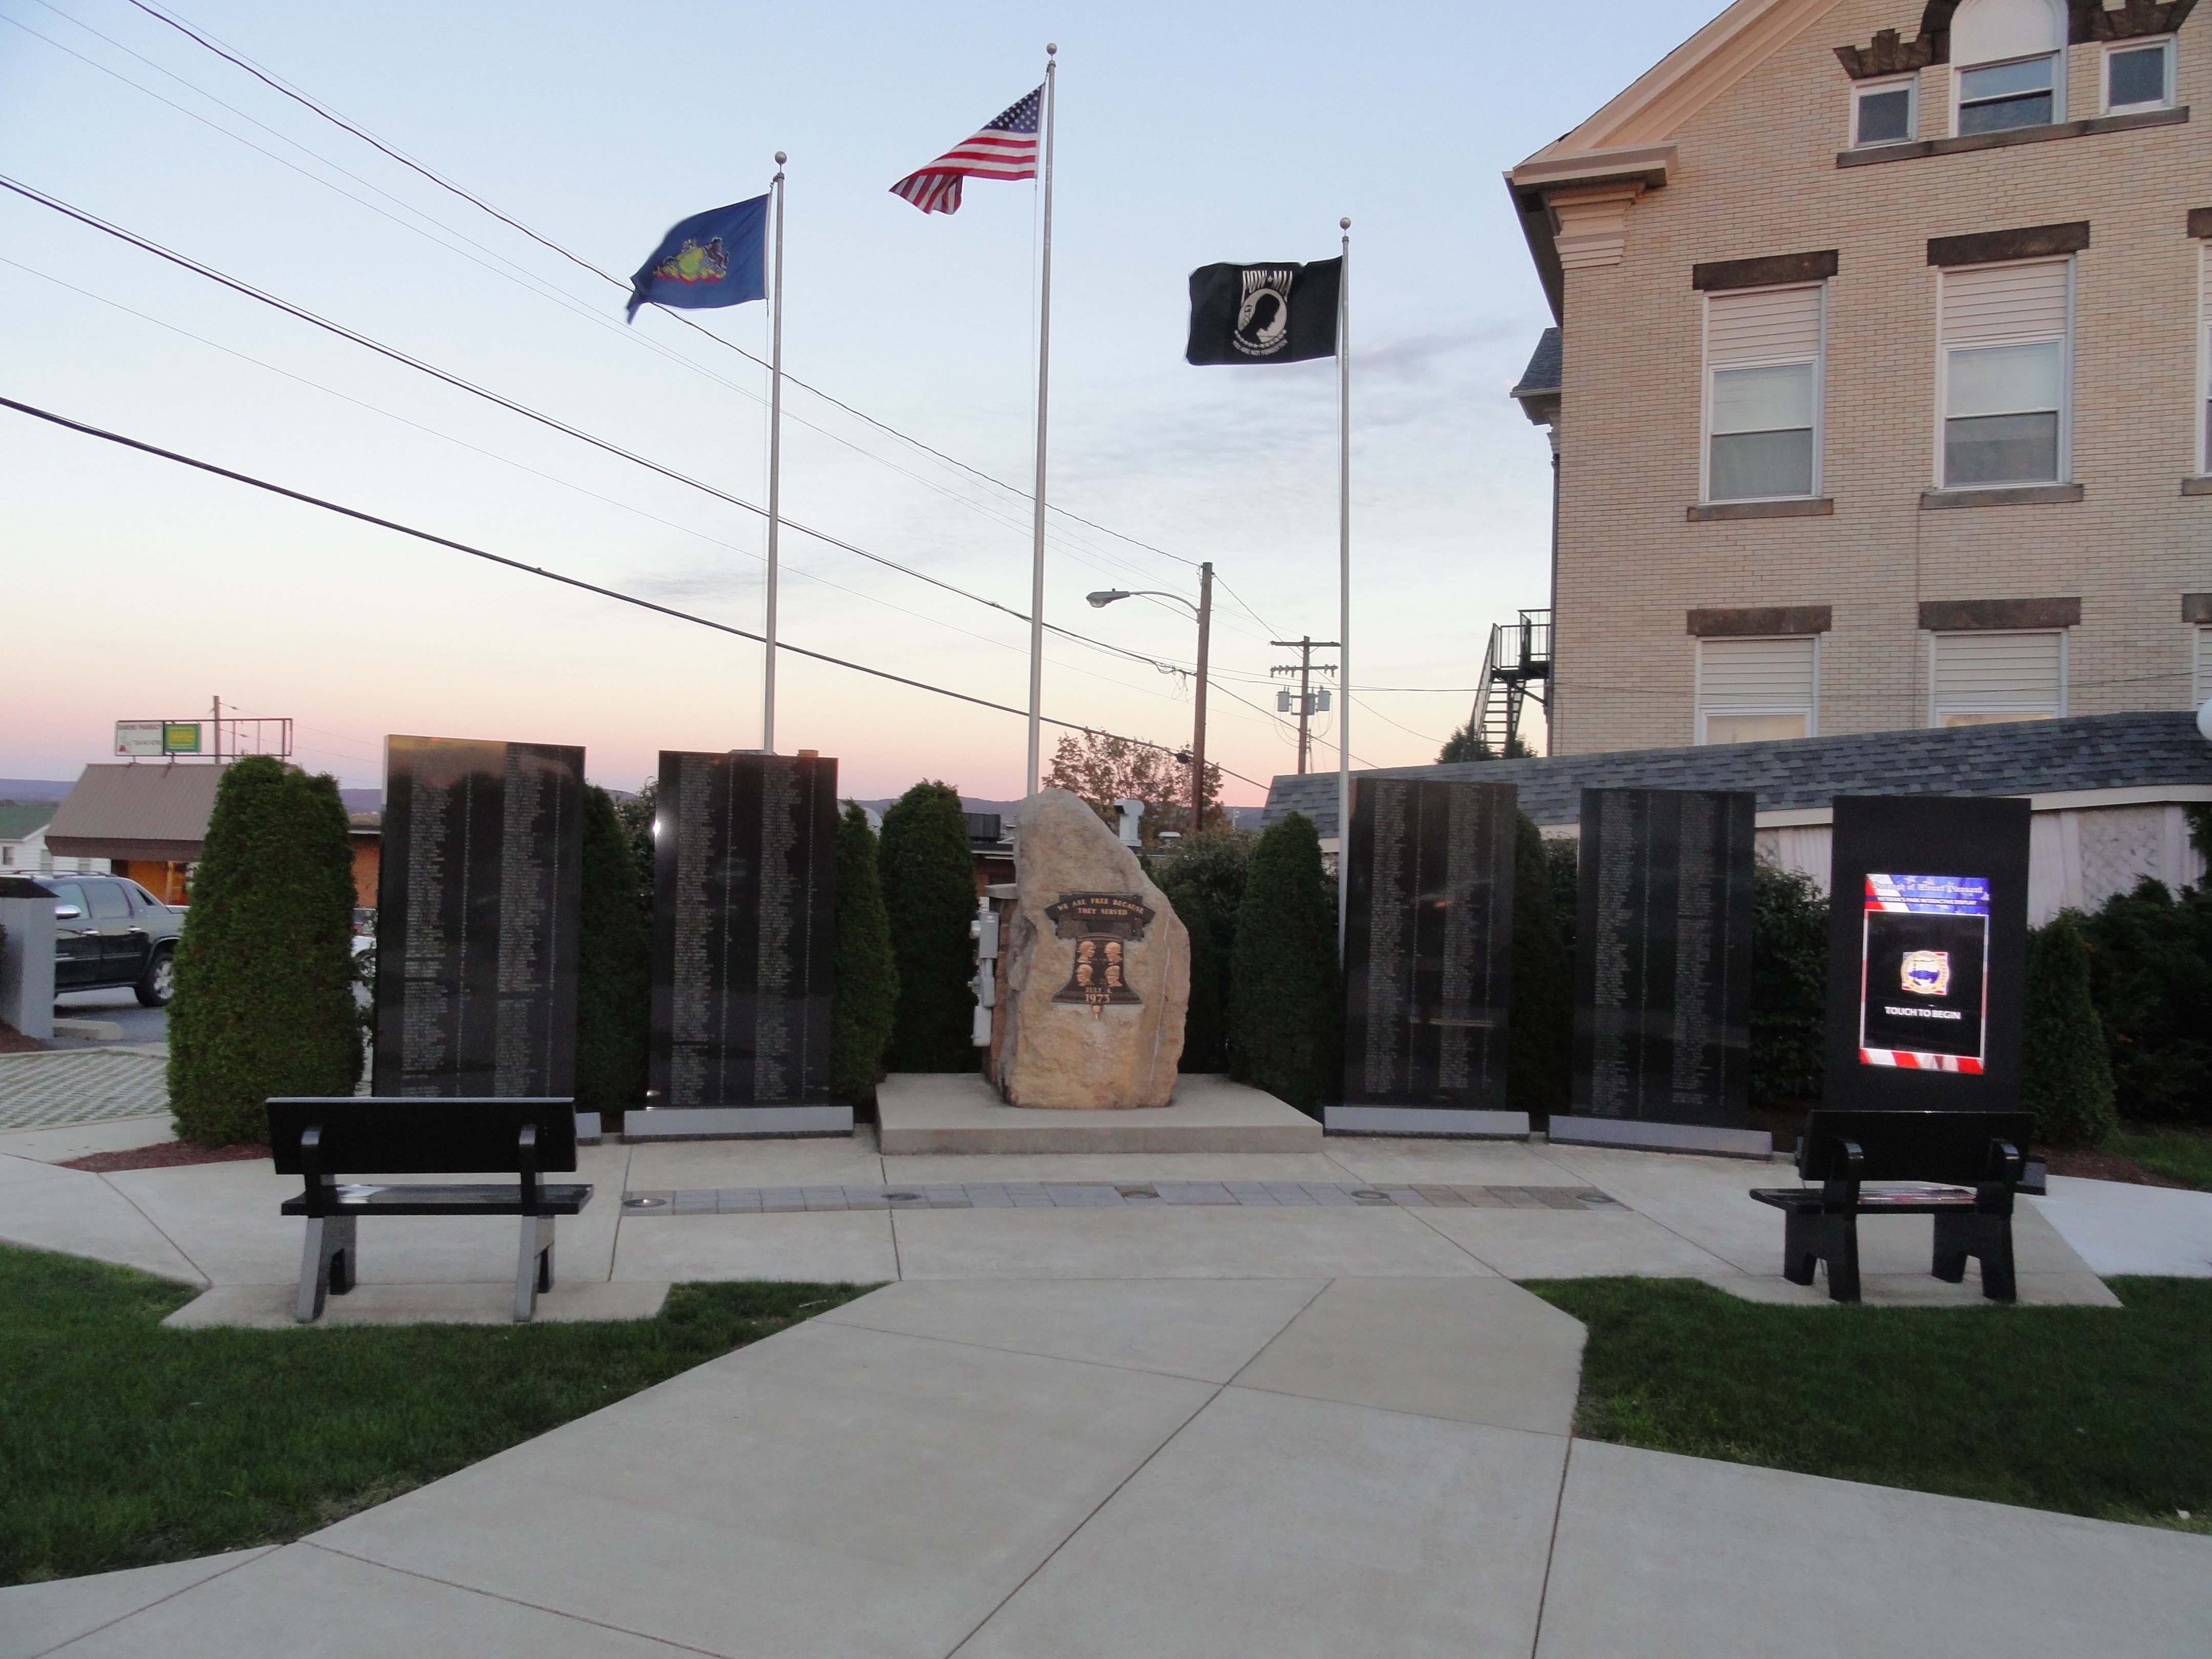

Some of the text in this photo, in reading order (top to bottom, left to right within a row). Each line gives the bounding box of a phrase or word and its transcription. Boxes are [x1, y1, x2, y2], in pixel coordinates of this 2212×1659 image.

[1241, 270, 1267, 306] POW
[1946, 885, 1983, 894] Pleasant
[1113, 899, 1145, 914] BECAUSE
[1884, 1007, 1918, 1016] TOUCH
[1931, 1010, 1961, 1019] BEGIN
